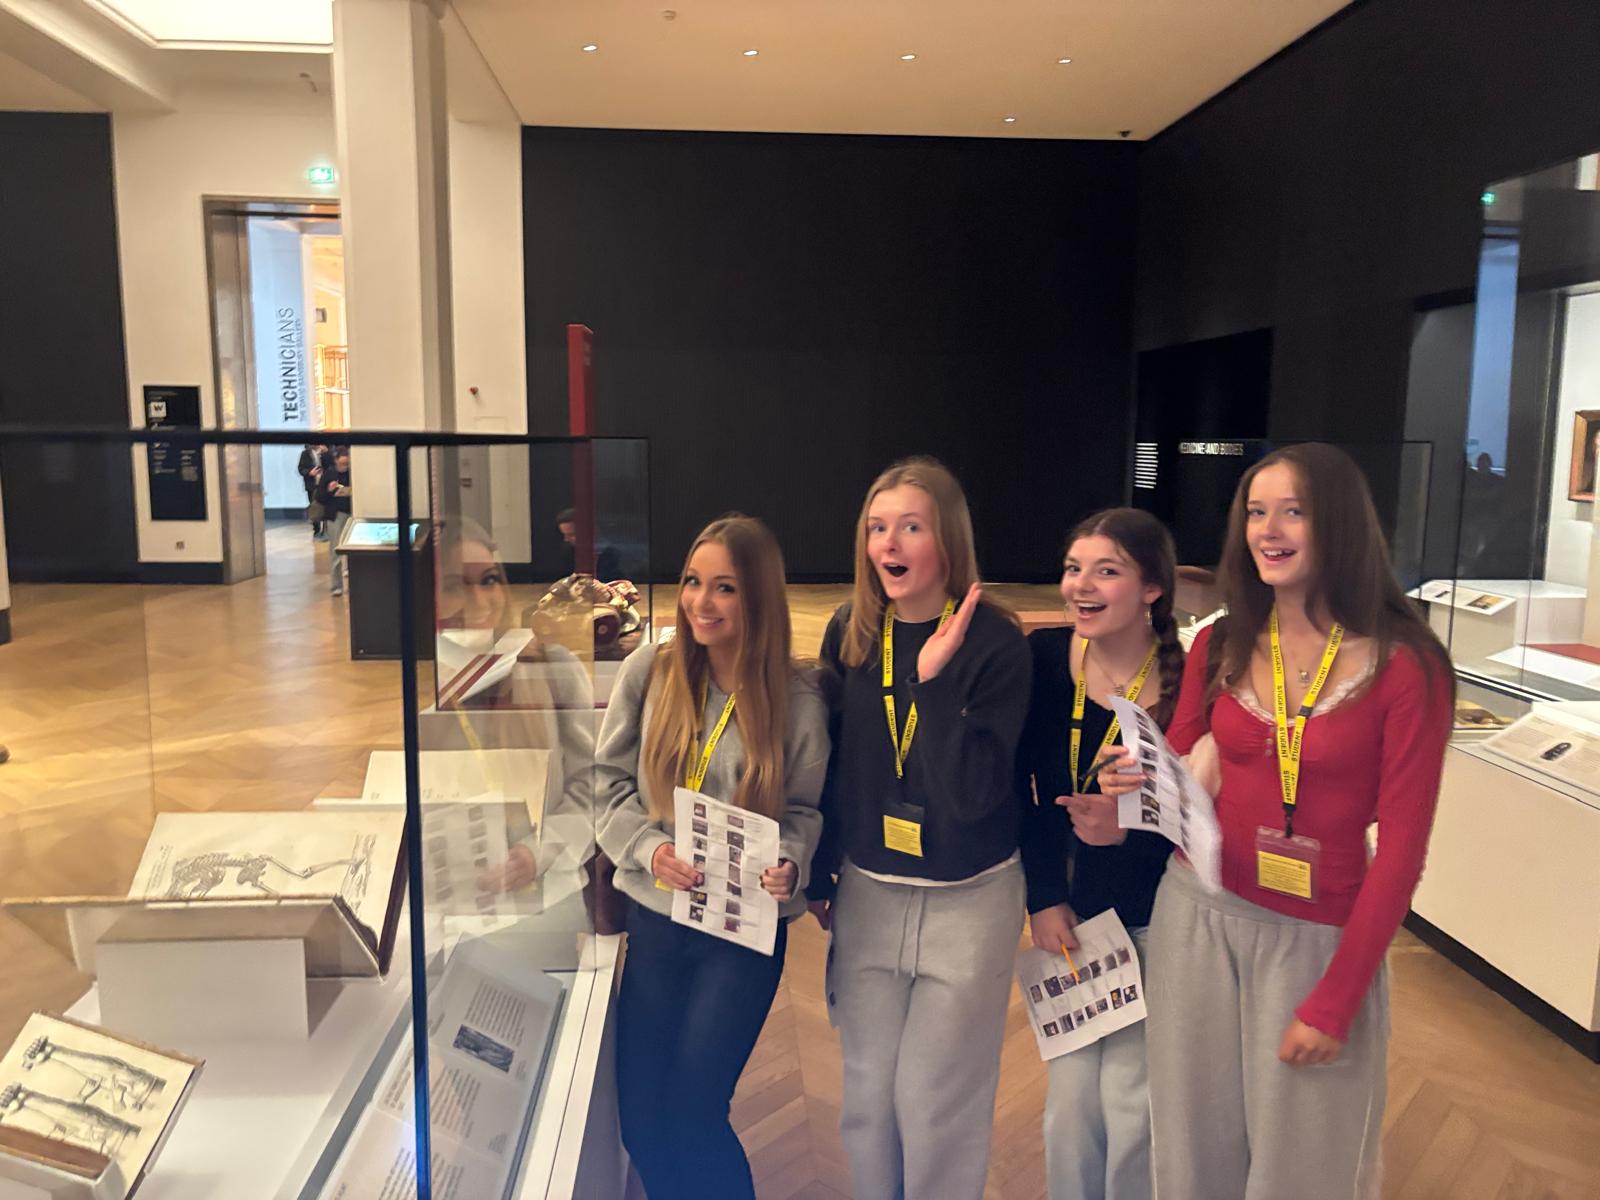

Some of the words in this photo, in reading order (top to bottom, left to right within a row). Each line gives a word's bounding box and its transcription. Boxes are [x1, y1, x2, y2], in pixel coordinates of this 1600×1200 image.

[278, 306, 299, 422] TECHNICIANS
[1077, 680, 1085, 707] STUDENT
[1311, 666, 1328, 695] STUDENT
[1277, 685, 1285, 715] STUDENT
[904, 713, 916, 741] STUDENT
[1280, 727, 1288, 758] STUDENT
[1291, 731, 1301, 762] STUDENT
[1283, 770, 1292, 802] STUDENT
